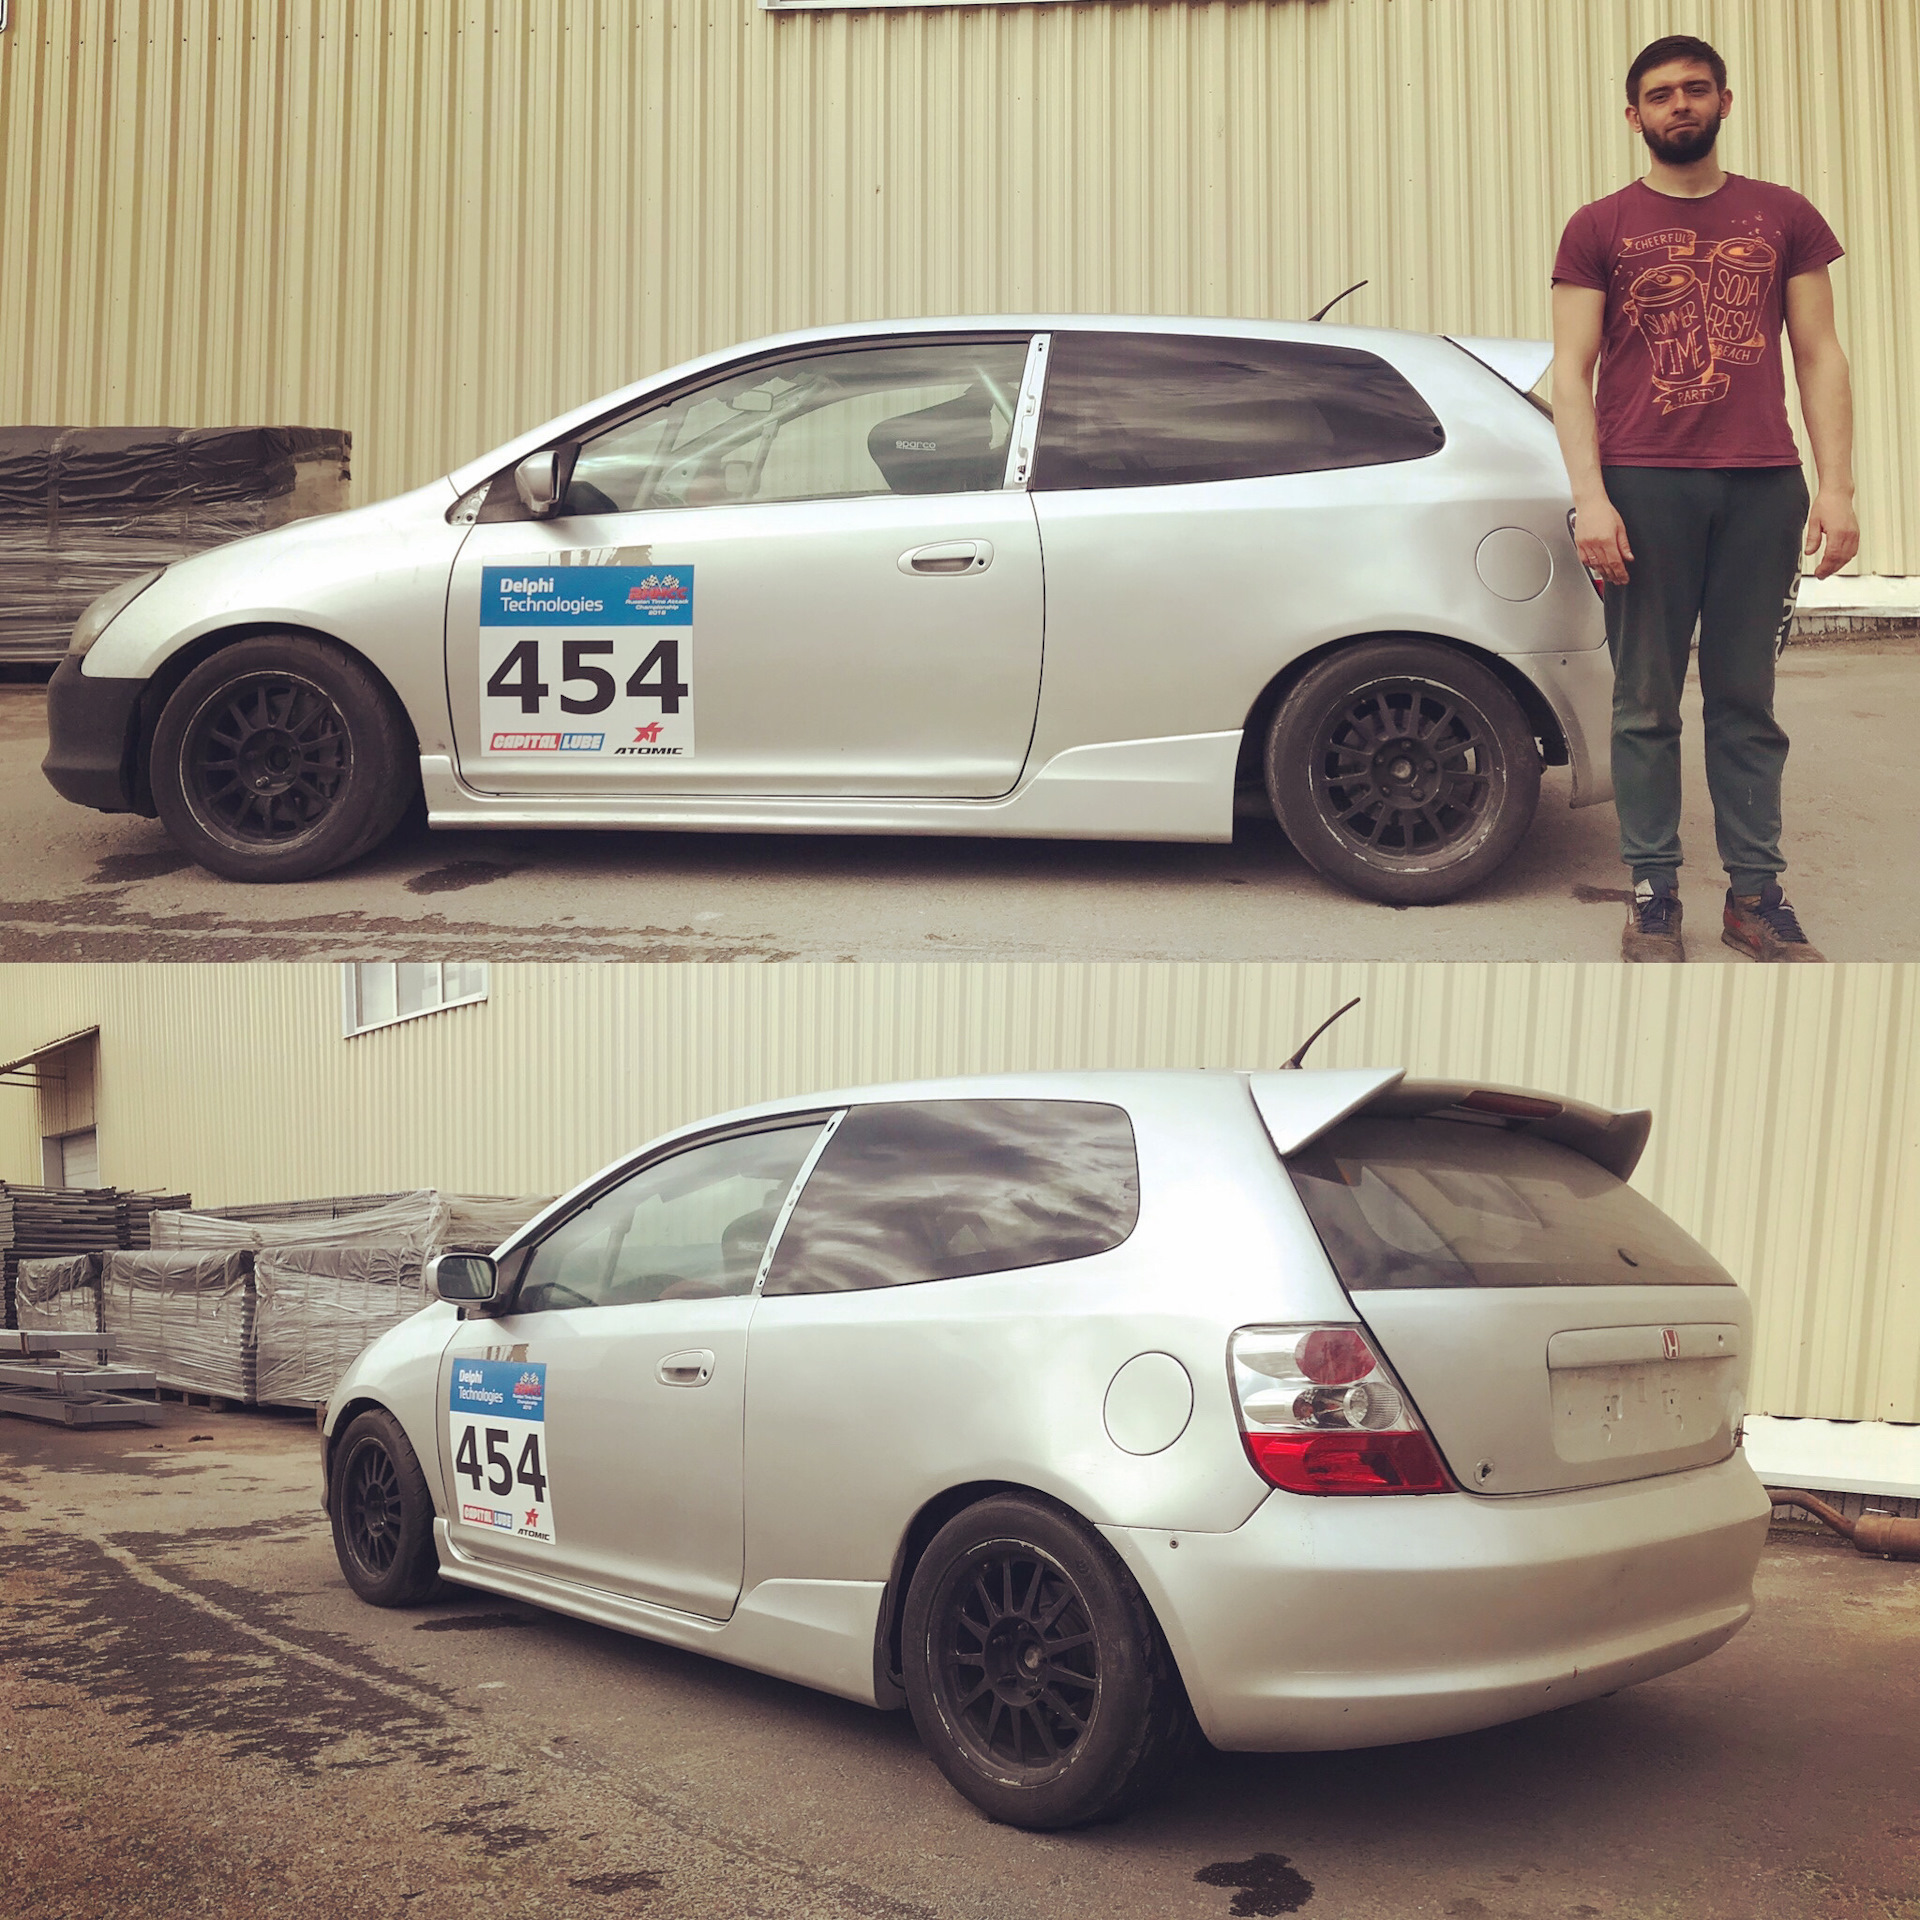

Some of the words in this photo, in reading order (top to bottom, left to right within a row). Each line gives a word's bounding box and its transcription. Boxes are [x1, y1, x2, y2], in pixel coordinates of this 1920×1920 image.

[1634, 233, 1687, 251] CHEERFUL
[1713, 268, 1759, 306] SODA
[1643, 300, 1699, 335] SUMMER
[1706, 302, 1756, 341] FRESH
[1654, 325, 1706, 375] TIME
[1717, 343, 1751, 362] BEACH
[1677, 387, 1717, 402] PARTY
[500, 577, 554, 596] Delphi
[500, 596, 604, 615] Technologies
[486, 639, 689, 715] 454
[492, 734, 558, 749] CAPITAL
[561, 734, 602, 749] LUBE
[614, 747, 684, 755] ATOMIC
[459, 1369, 483, 1386] Delphi
[458, 1386, 504, 1405] Technologies
[456, 1425, 547, 1503] 454
[517, 1528, 551, 1541] ATOMIC
